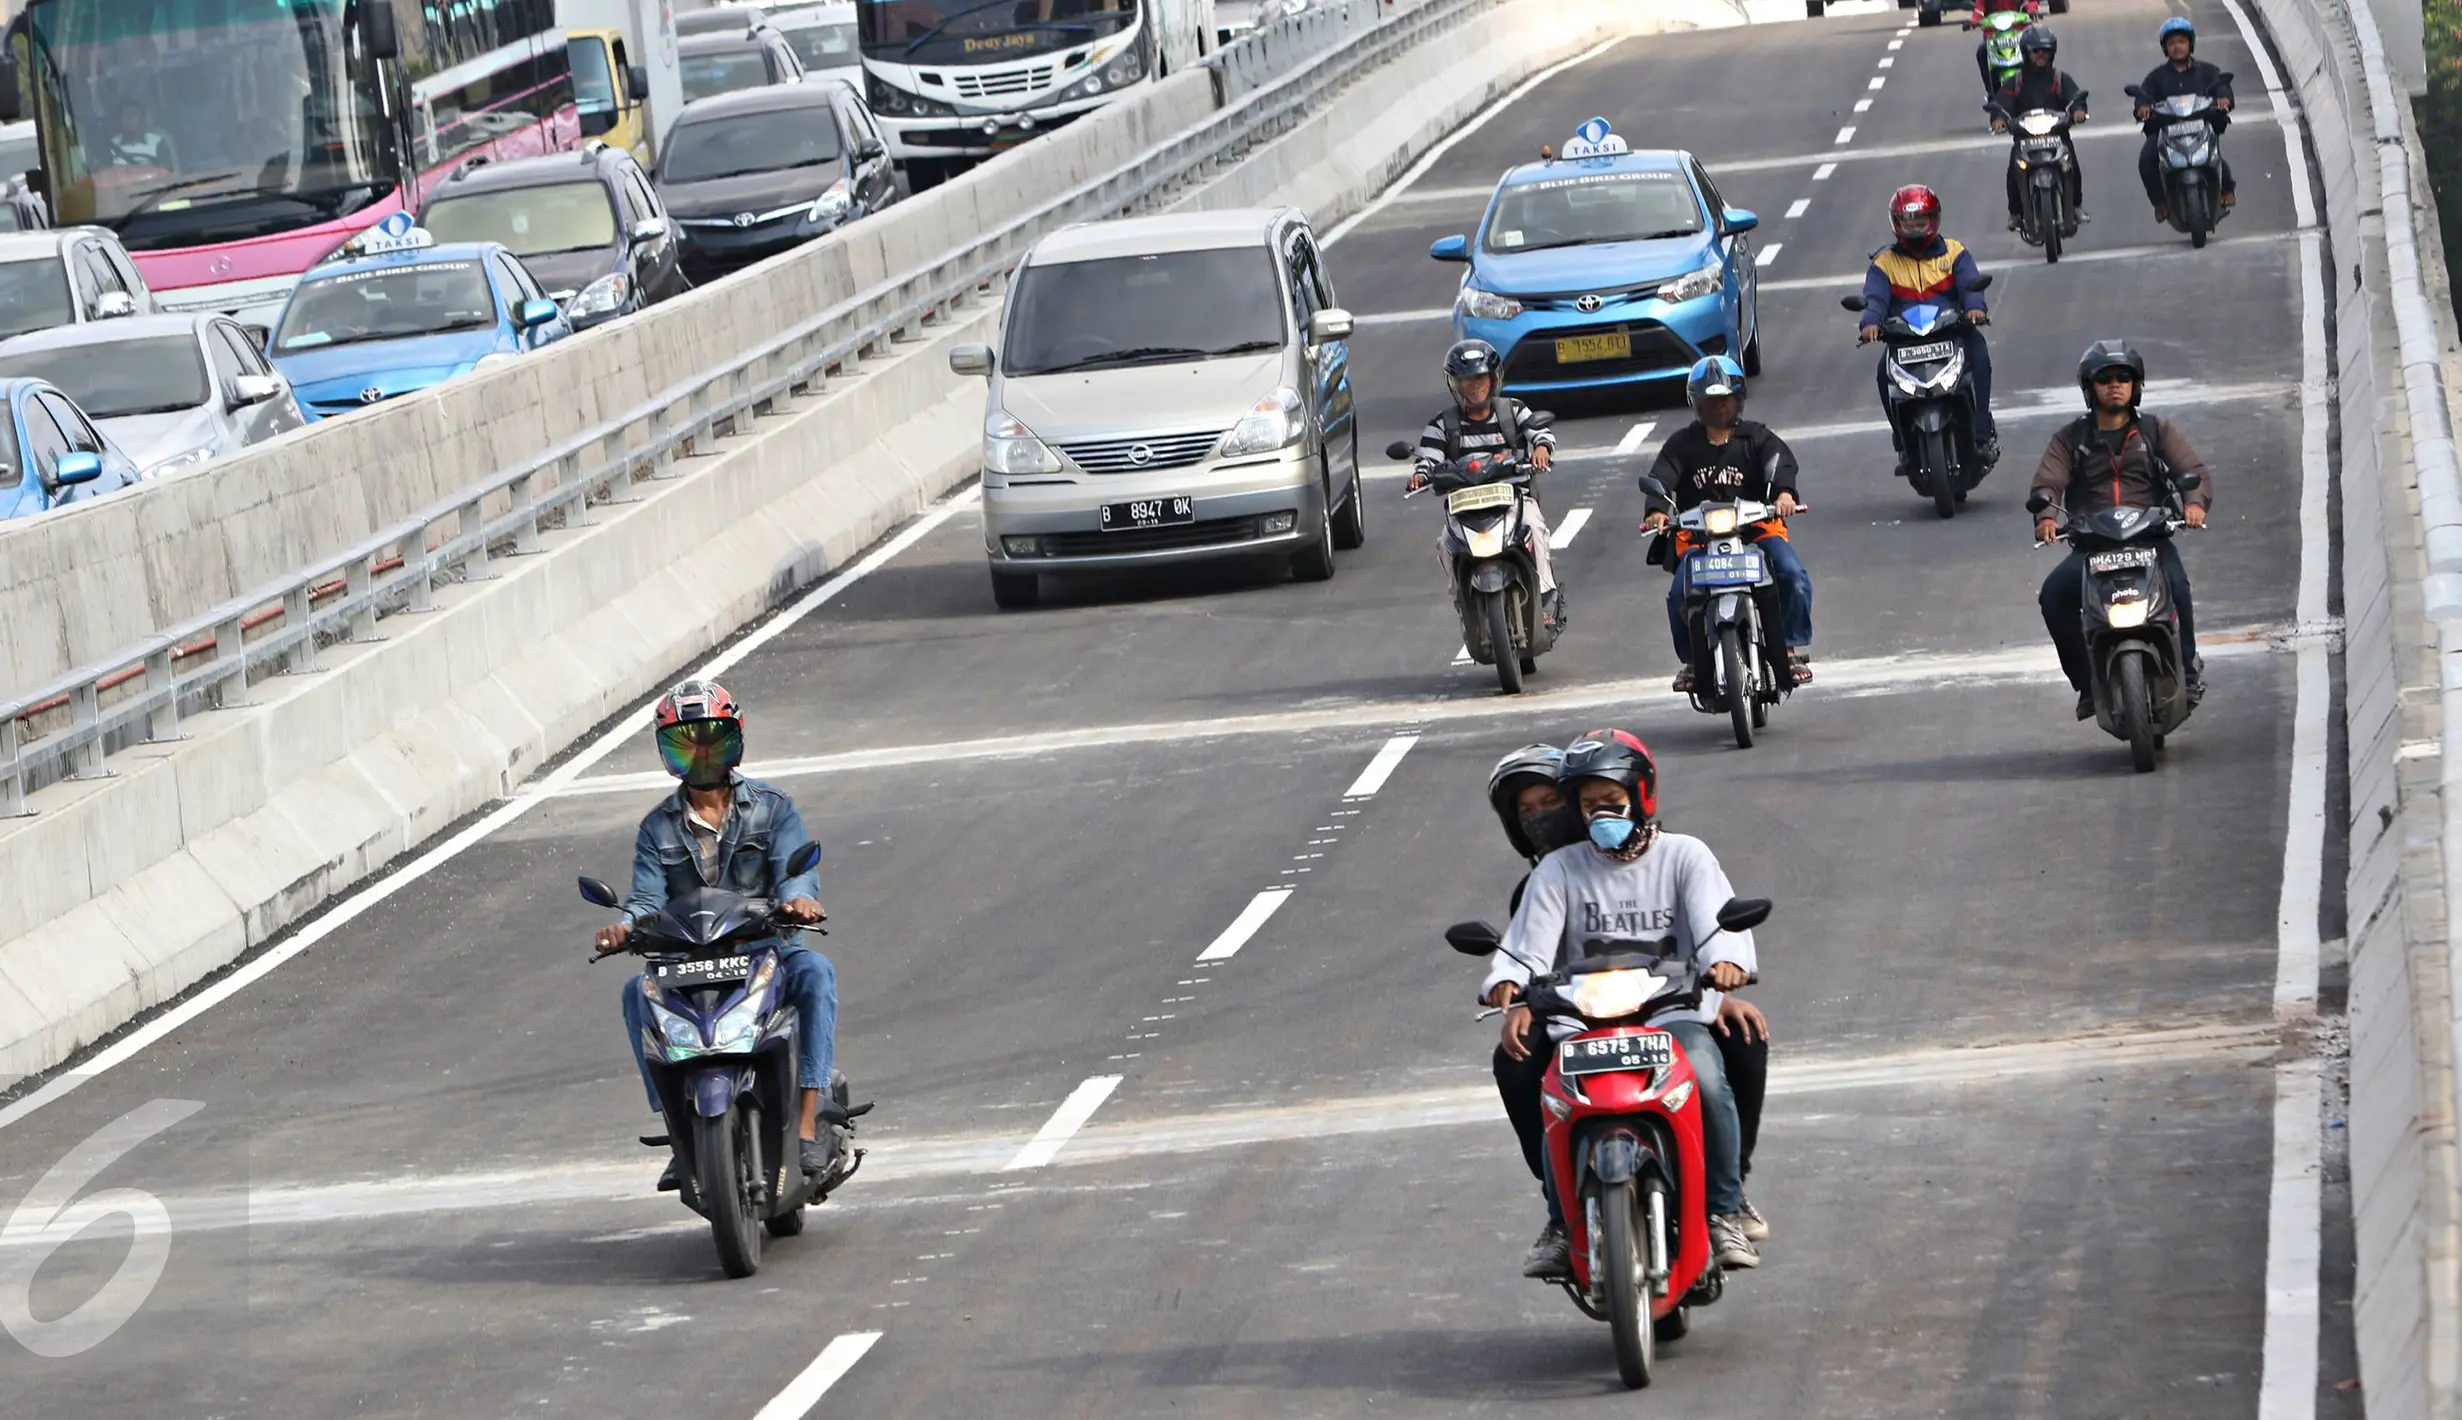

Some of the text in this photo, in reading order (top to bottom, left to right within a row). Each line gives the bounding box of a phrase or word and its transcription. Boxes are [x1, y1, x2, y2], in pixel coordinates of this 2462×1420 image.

[1573, 143, 1617, 156] TAKSI
[1540, 172, 1672, 189] BLUE BIRD GROUP
[375, 236, 420, 250] TAKSI
[336, 263, 471, 283] BLUE BIRD GROUP
[1102, 506, 1111, 522] B
[1130, 500, 1163, 519] 8947
[1694, 560, 1701, 572] B
[1708, 557, 1734, 571] 4084
[2111, 587, 2139, 603] photo
[1618, 899, 1638, 910] THE
[1584, 902, 1674, 937] BEATLES
[658, 955, 749, 977] B 3556 KKC
[1564, 1035, 1669, 1057] B 6575 THA
